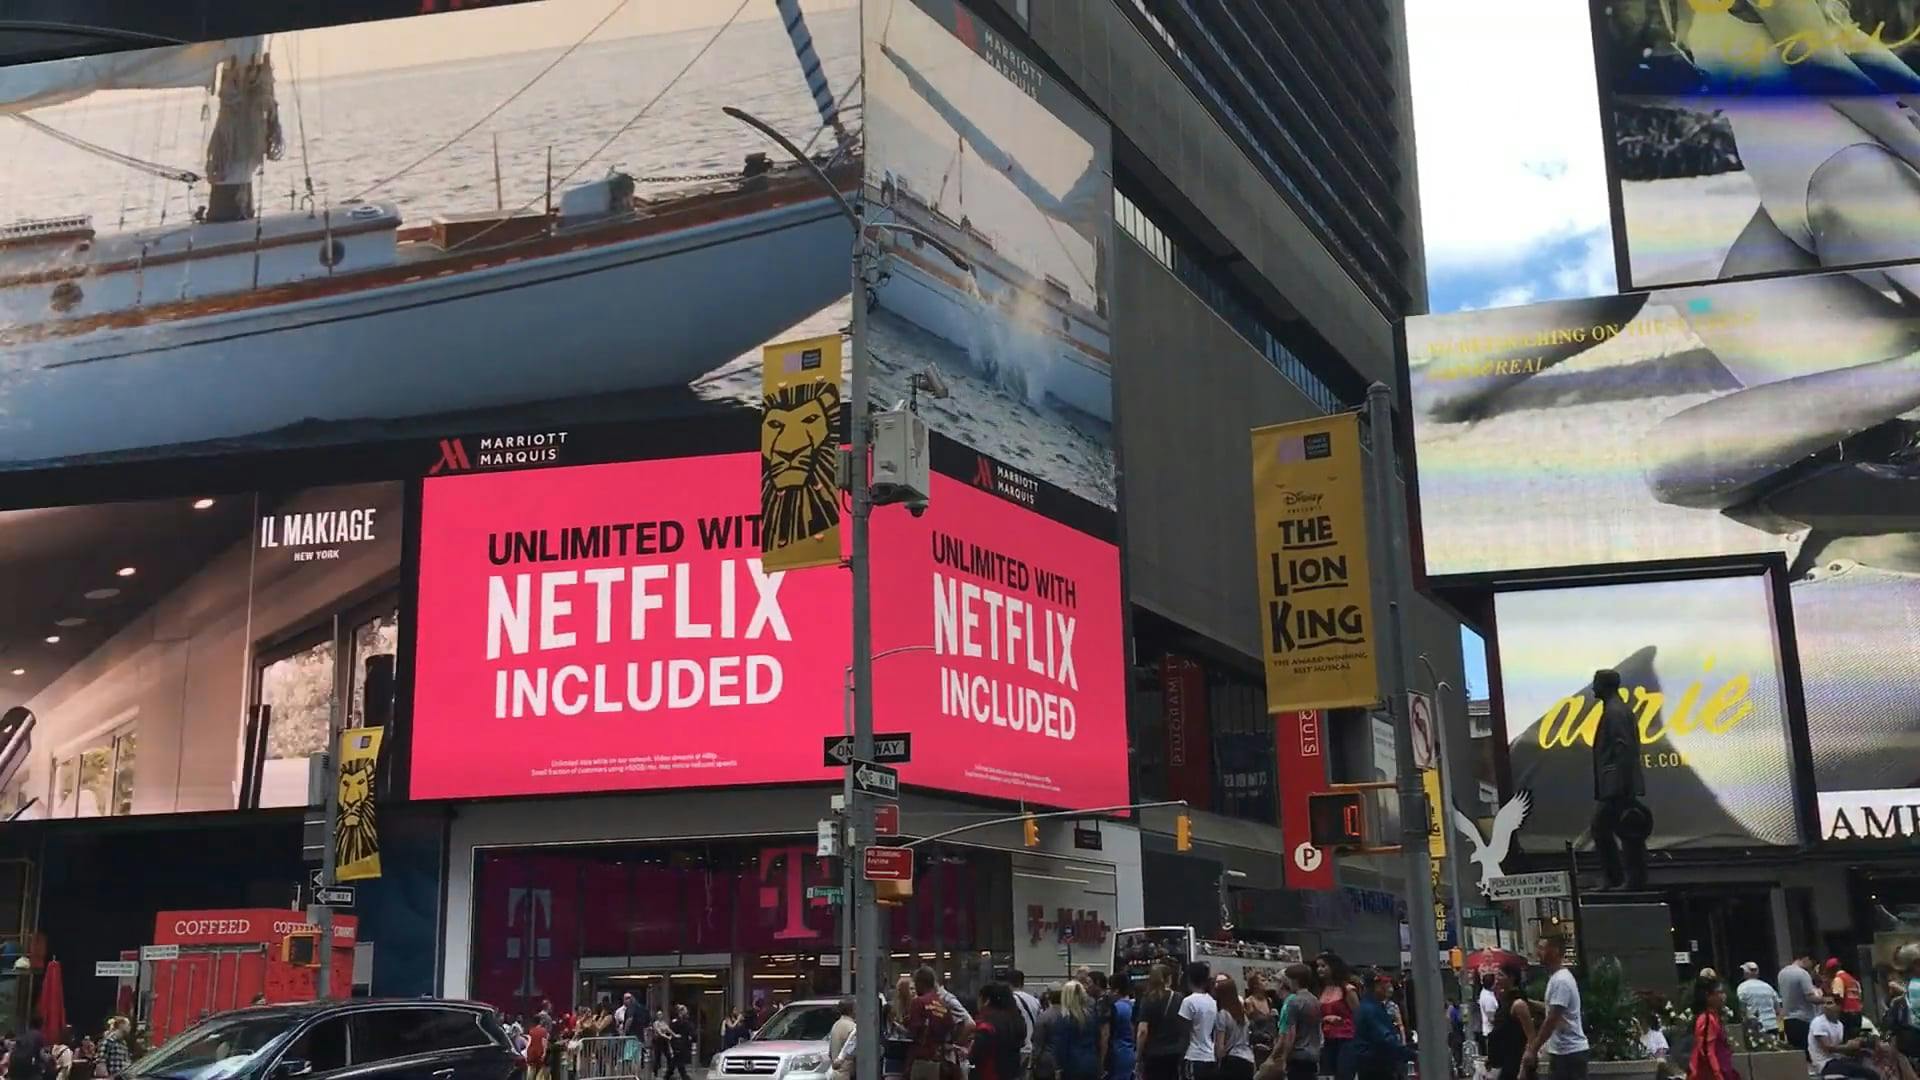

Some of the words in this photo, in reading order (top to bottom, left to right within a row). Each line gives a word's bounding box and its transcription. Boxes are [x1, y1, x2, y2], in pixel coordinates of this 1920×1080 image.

[985, 31, 1043, 87] MARRIOTT
[985, 50, 1038, 101] MARQUIS
[1592, 323, 1620, 342] ON
[480, 432, 568, 449] MARRIOTT
[480, 449, 557, 466] MARQUIS
[997, 465, 1039, 492] MARRIOTT
[997, 481, 1035, 505] MARQUIS
[261, 516, 279, 548] IL
[283, 508, 376, 546] MAKIAGE
[488, 520, 684, 565] UNLIMITED
[697, 514, 763, 551] WIT
[1278, 515, 1333, 544] THE
[294, 551, 314, 561] NEW
[316, 549, 340, 560] YORK
[932, 530, 1030, 592] UNLIMITED
[1033, 566, 1077, 609] WITH
[486, 558, 793, 660] NETFLIX
[933, 571, 1080, 693] NETFLIX
[495, 654, 783, 719] INCLUDED
[940, 666, 1077, 740] INCLUDED
[1300, 709, 1316, 753] QUIS
[837, 744, 854, 757] ON
[879, 774, 893, 788] WAY
[1303, 848, 1316, 866] P
[174, 919, 251, 936] COFFEED
